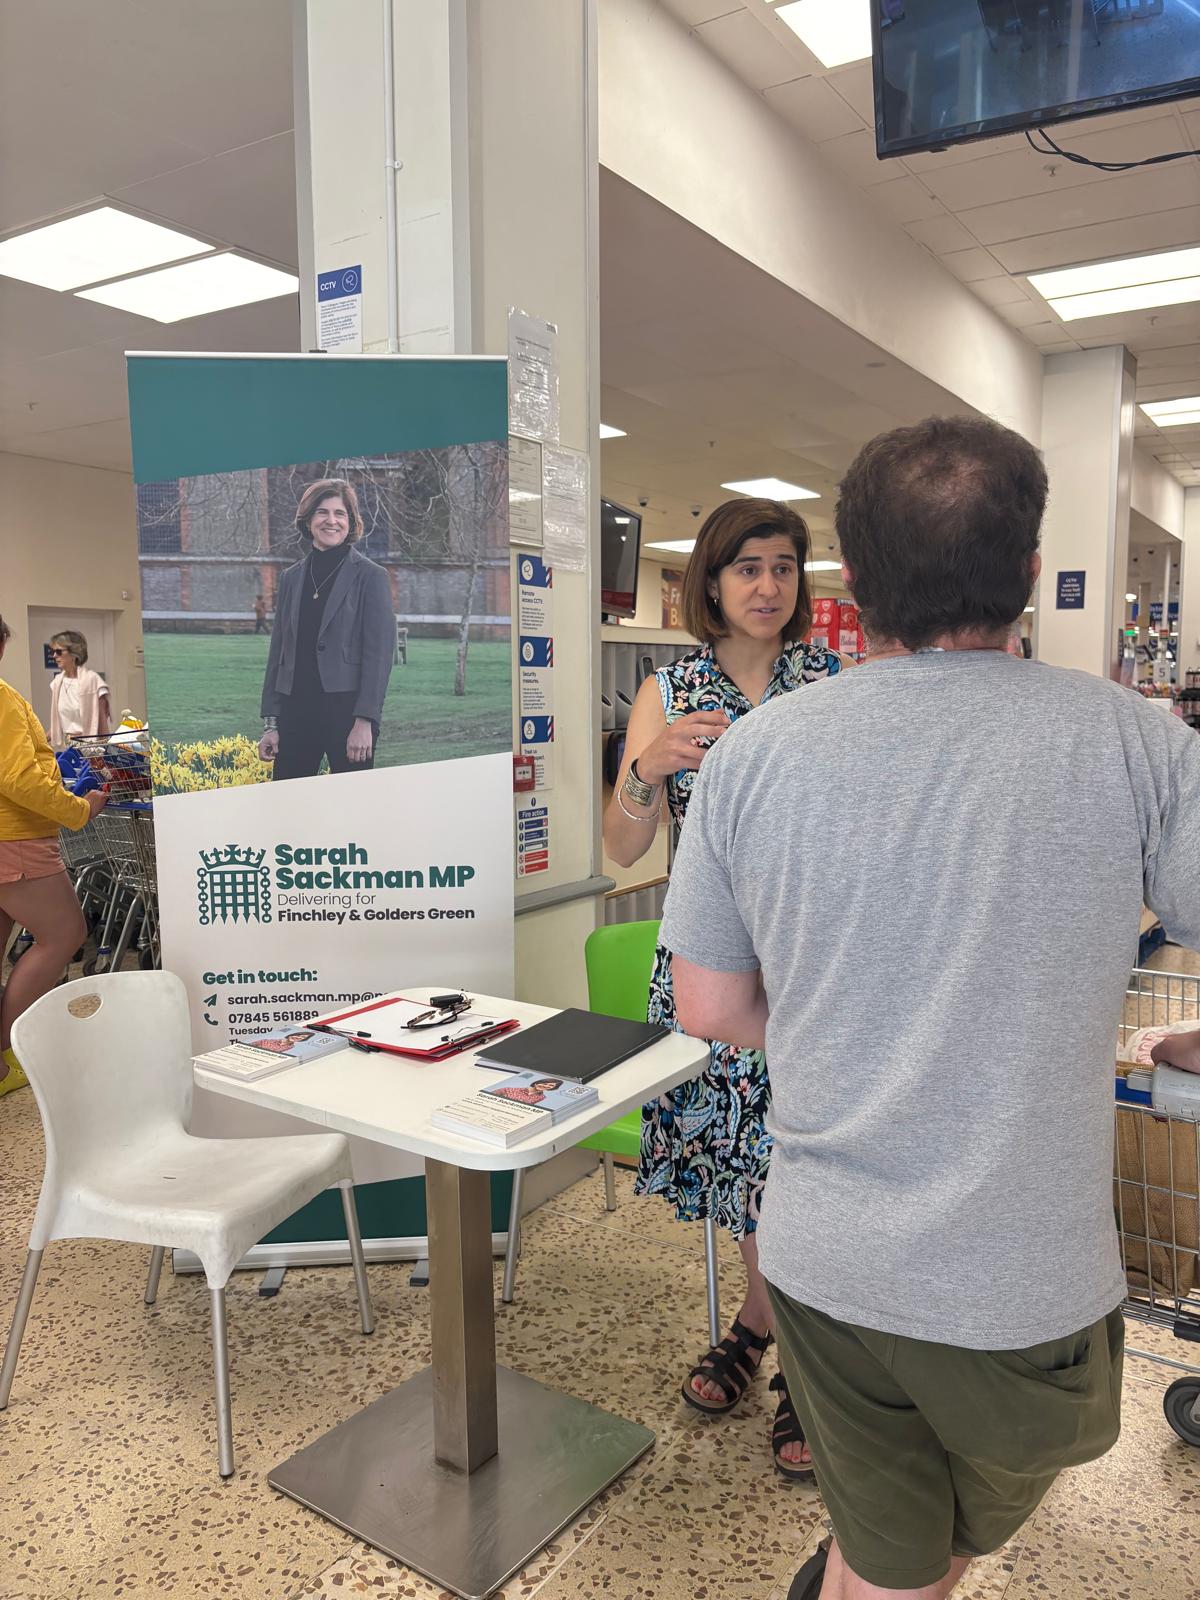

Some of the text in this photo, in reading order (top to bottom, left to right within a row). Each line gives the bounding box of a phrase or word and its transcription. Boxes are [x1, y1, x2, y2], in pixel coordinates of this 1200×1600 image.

[320, 281, 337, 291] CCTV
[1159, 667, 1166, 678] 5
[531, 809, 545, 817] action
[275, 842, 368, 865] Sarah
[275, 865, 476, 890] Sackman MP
[277, 892, 377, 909] Delivering for
[278, 907, 476, 925] Finchley & Golders Green
[202, 967, 319, 985] Get in touch:
[228, 1010, 320, 1024] 07845 561889
[476, 1093, 498, 1102] Sarah
[497, 1099, 531, 1111] Sackman
